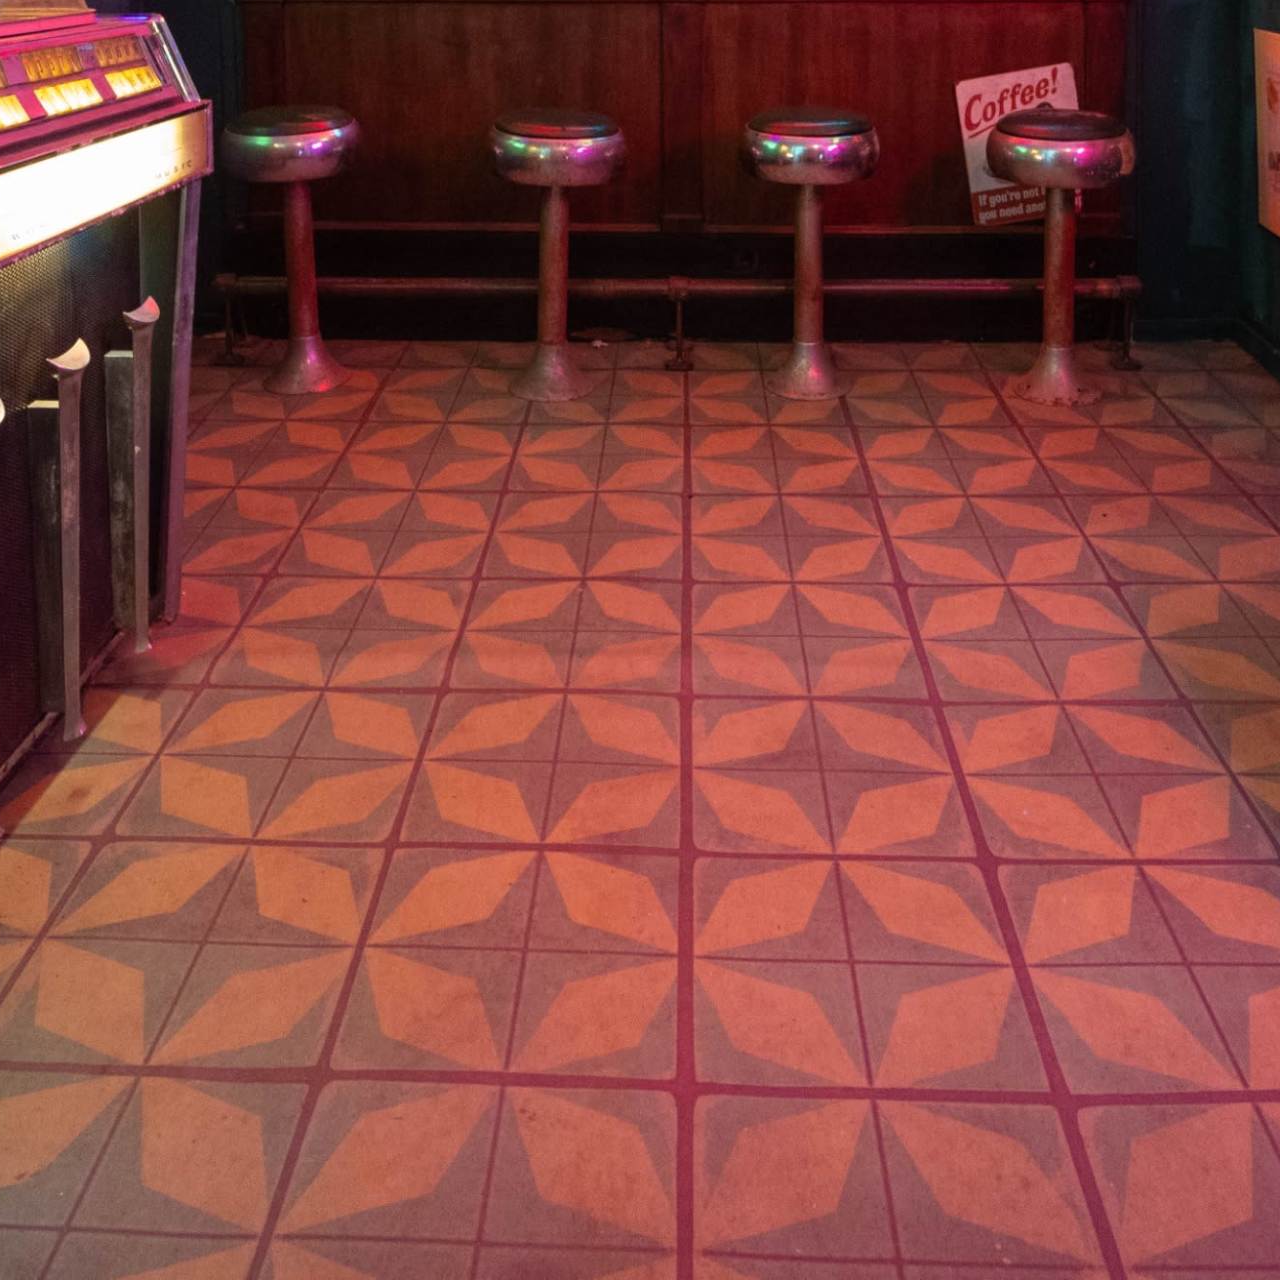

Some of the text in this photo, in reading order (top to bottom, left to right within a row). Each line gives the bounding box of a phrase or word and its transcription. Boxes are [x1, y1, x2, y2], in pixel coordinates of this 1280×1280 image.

[964, 66, 1058, 131] Coffee!
[156, 159, 193, 180] MUSIC
[989, 190, 1021, 208] you're
[1023, 187, 1039, 200] not
